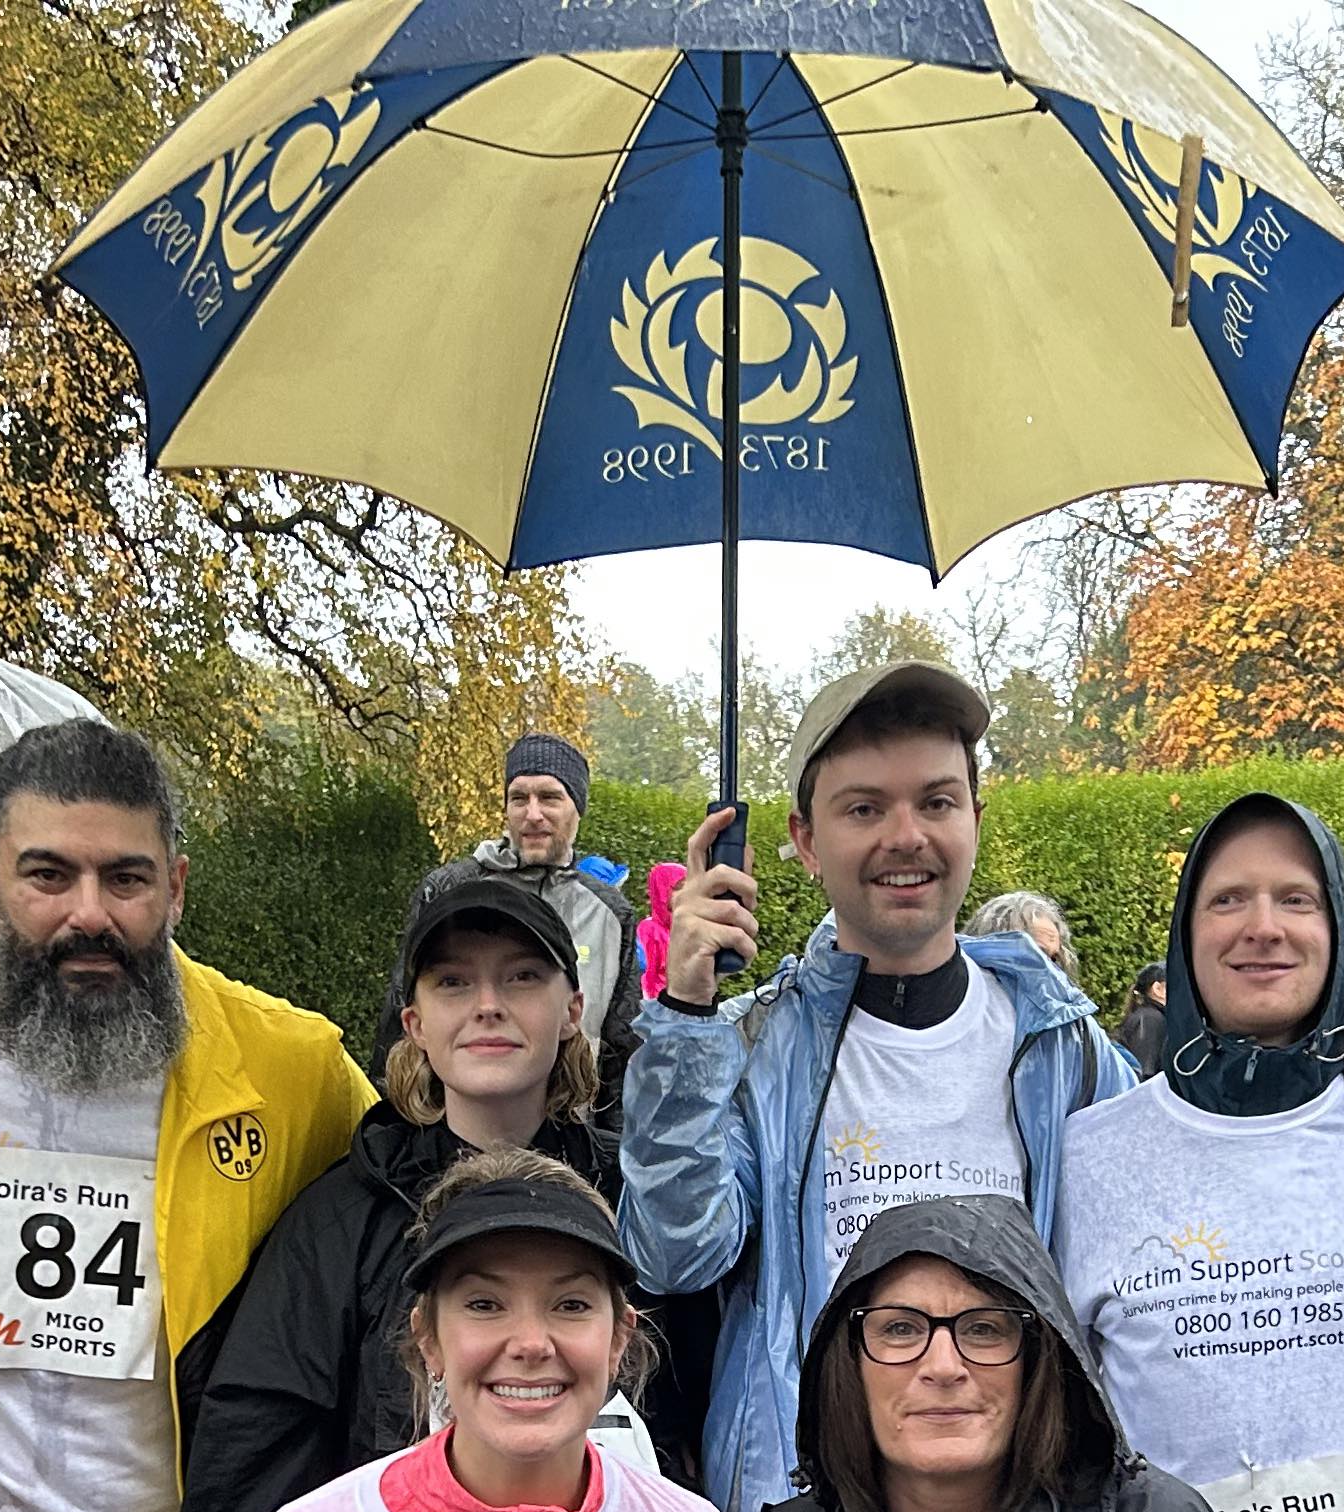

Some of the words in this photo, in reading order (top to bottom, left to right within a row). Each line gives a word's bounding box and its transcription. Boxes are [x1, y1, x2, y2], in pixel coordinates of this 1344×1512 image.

[214, 1117, 262, 1165] BVB
[849, 1161, 942, 1184] Support
[77, 1185, 130, 1210] Run
[873, 1192, 889, 1206] by
[1113, 1265, 1181, 1297] Victim
[1190, 1252, 1294, 1283] Support
[1122, 1296, 1175, 1319] Surviving
[1178, 1293, 1216, 1308] crime
[1221, 1290, 1237, 1304] by
[1241, 1285, 1293, 1302] making
[1296, 1280, 1344, 1297] people
[45, 1311, 104, 1333] MIGO
[1175, 1314, 1231, 1335] 0800
[1240, 1309, 1281, 1330] 160
[1290, 1302, 1344, 1324] 1985
[30, 1334, 116, 1358] SPORTS
[1173, 1331, 1344, 1359] victimsupport.scot
